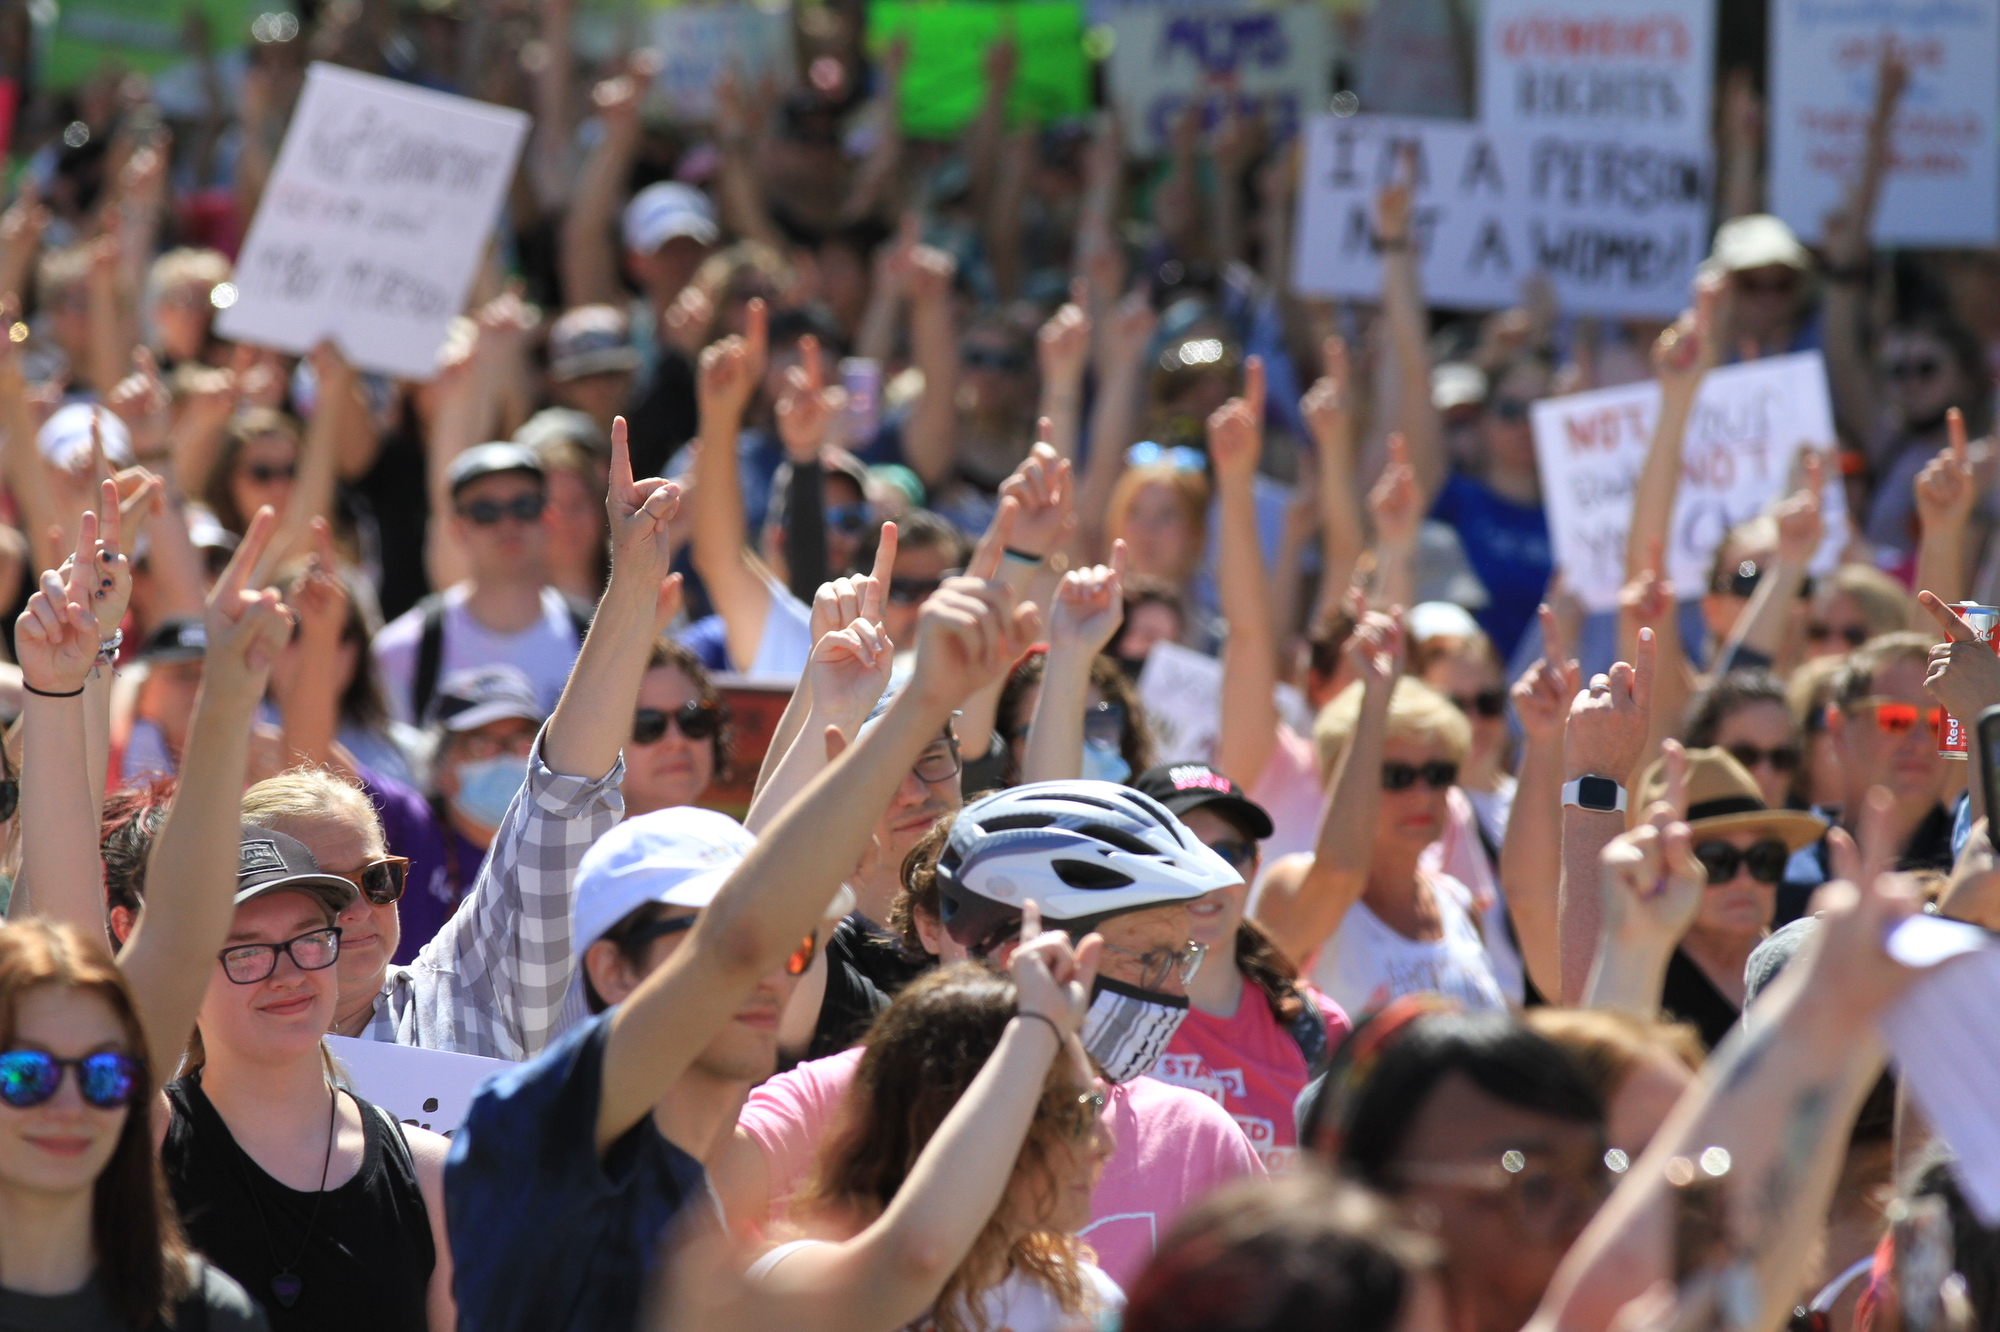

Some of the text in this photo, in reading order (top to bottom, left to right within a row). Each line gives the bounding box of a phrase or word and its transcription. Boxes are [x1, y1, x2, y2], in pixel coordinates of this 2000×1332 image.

[1459, 135, 1506, 196] A
[1466, 213, 1513, 275] A
[1946, 718, 1959, 746] Red
